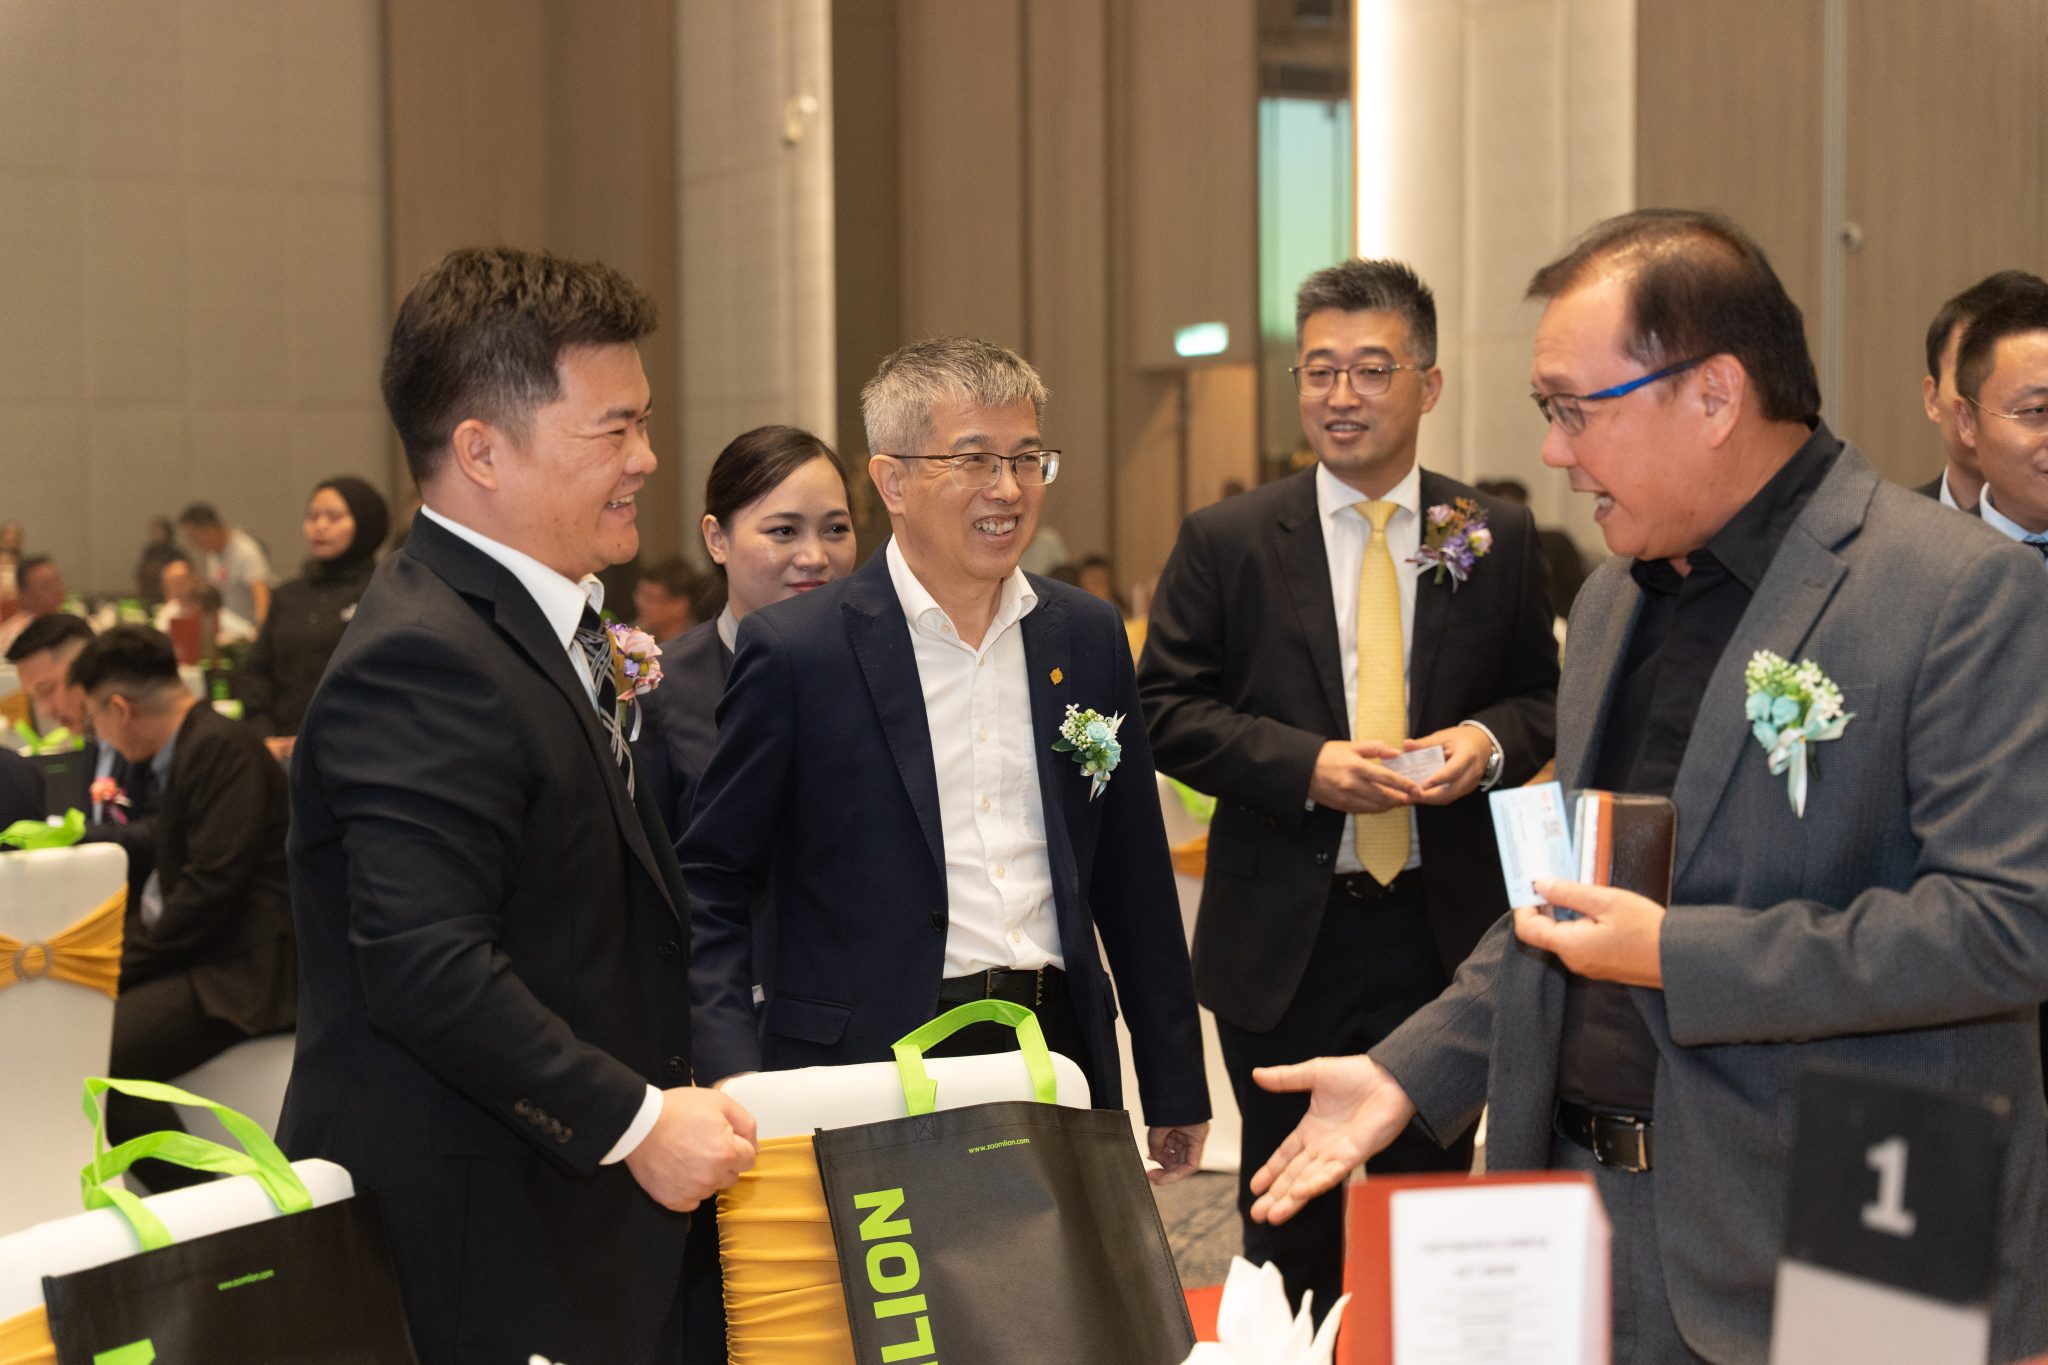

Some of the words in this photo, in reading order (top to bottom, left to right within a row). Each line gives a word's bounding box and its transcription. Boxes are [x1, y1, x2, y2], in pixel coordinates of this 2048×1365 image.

[968, 1138, 1030, 1153] www.zoomlion.com
[1861, 1138, 1917, 1239] 1
[853, 1187, 938, 1365] LION
